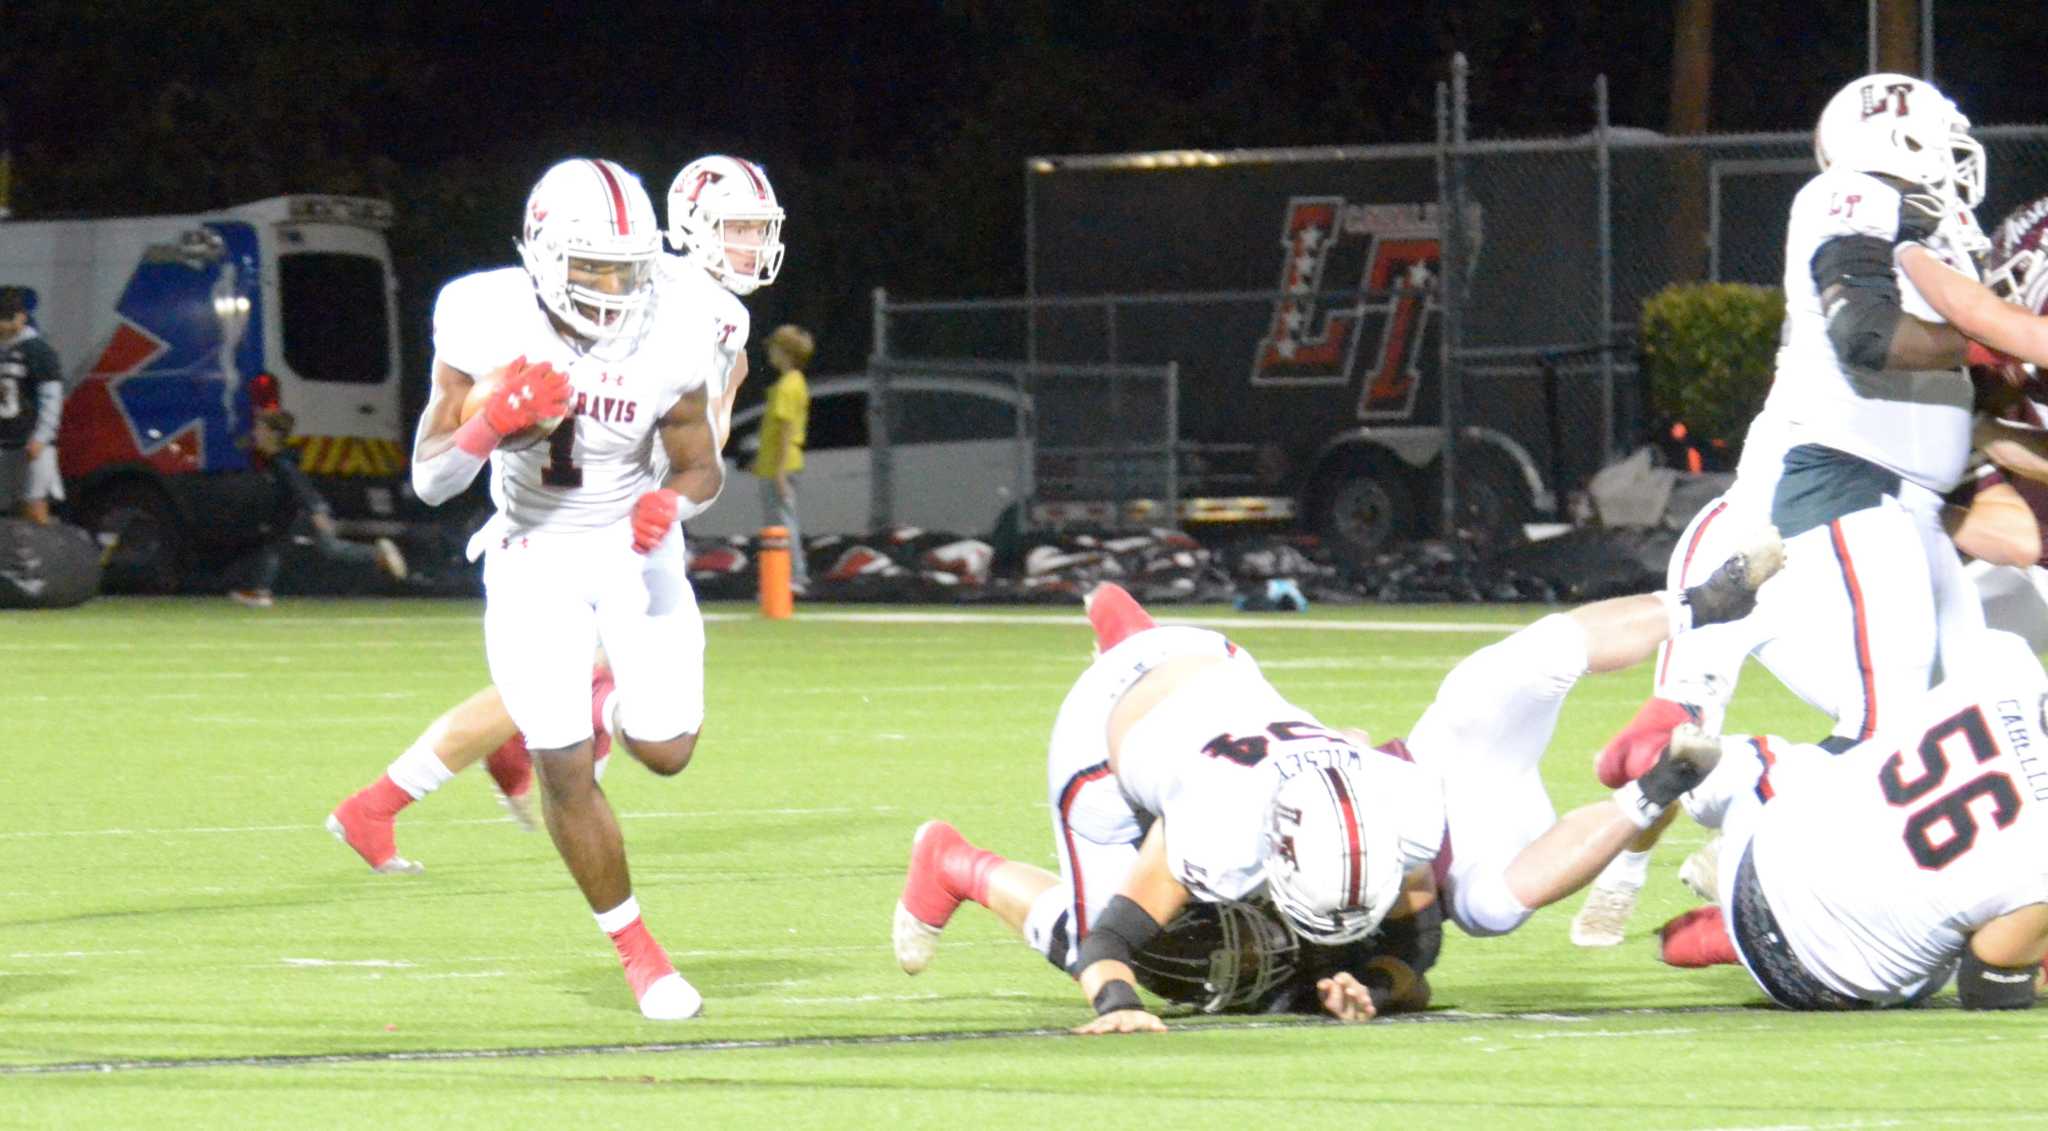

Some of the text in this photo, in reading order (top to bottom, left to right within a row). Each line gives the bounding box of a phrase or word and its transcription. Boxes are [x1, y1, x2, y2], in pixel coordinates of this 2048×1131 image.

[1861, 83, 1915, 121] LT
[1829, 192, 1862, 218] LT
[1250, 195, 1472, 420] LT
[575, 391, 638, 424] RAVIS
[1878, 704, 2024, 871] 56
